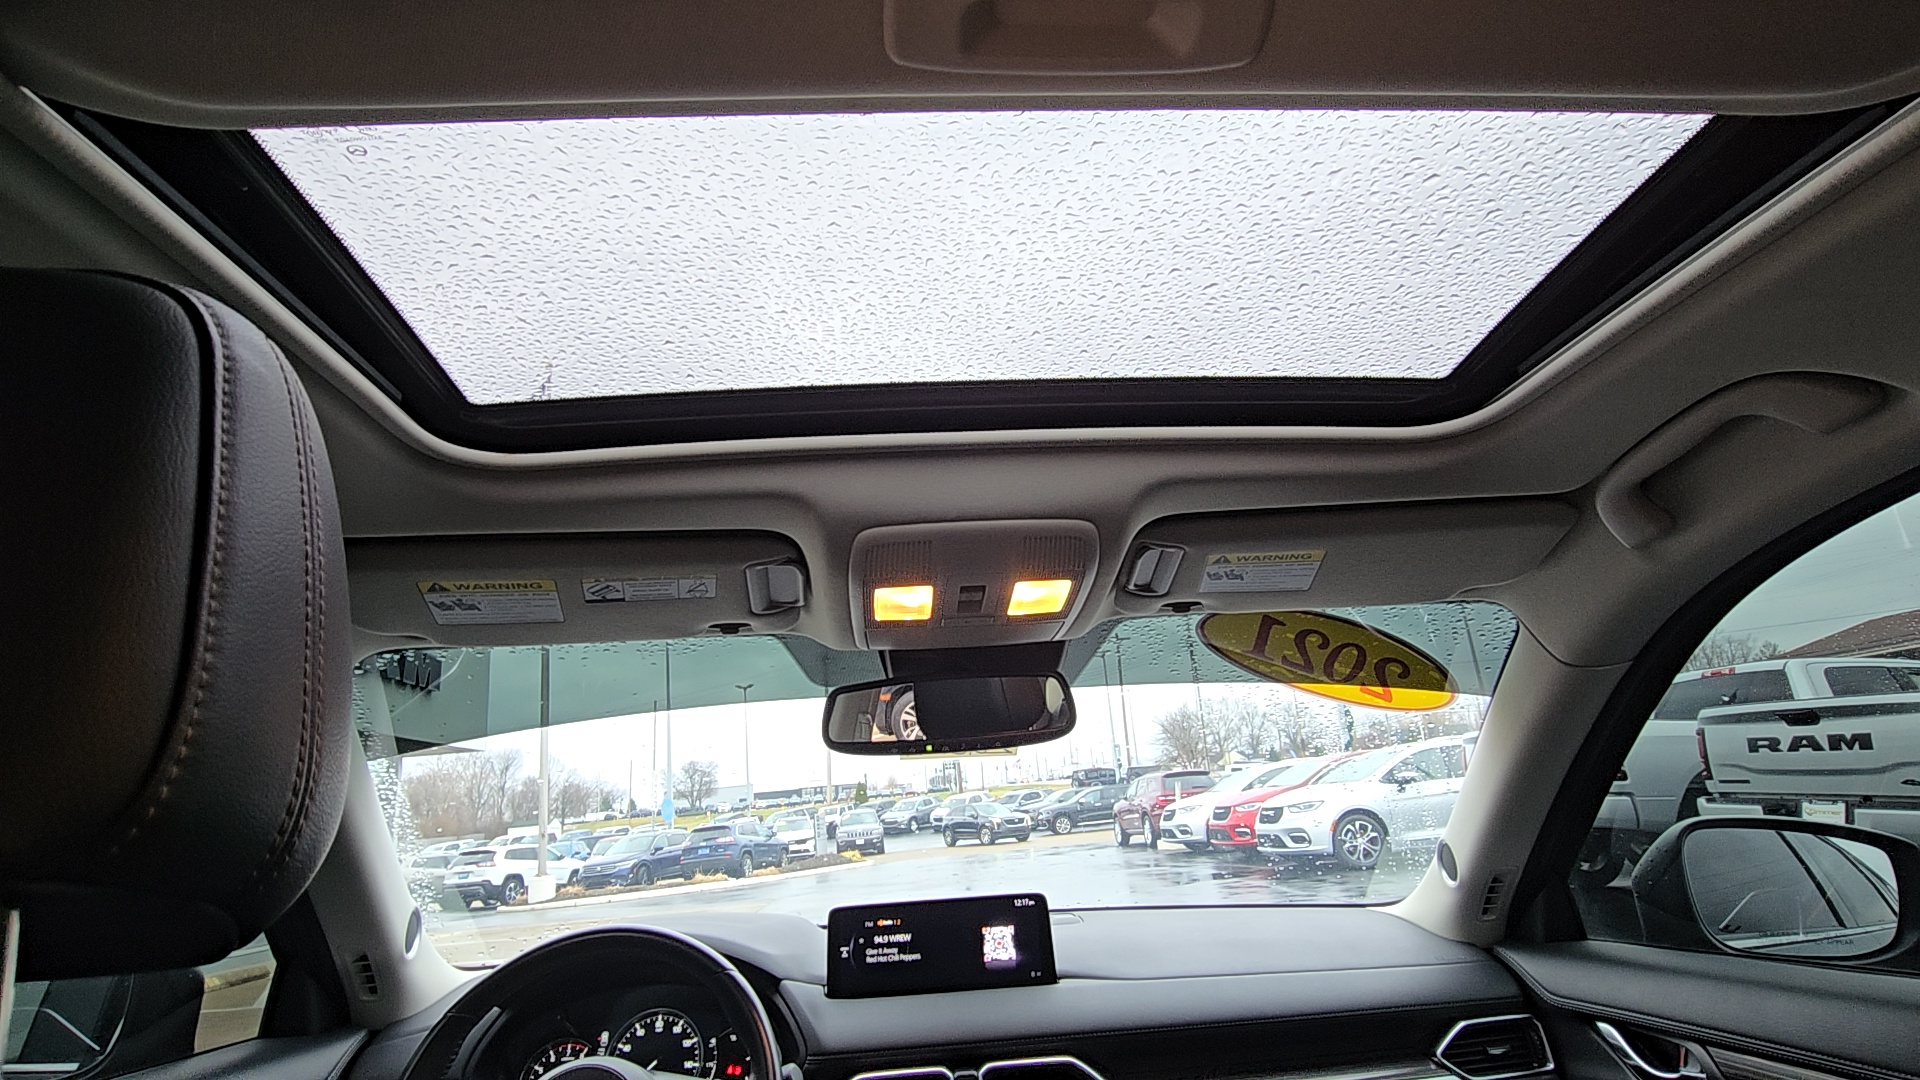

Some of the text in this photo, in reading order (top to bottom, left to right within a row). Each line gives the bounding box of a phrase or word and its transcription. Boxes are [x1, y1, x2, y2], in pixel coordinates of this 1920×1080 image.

[1236, 553, 1313, 562] WARNING
[452, 582, 543, 591] WARNING
[1746, 732, 1874, 754] RAM
[873, 932, 912, 945] 94.9 WREW
